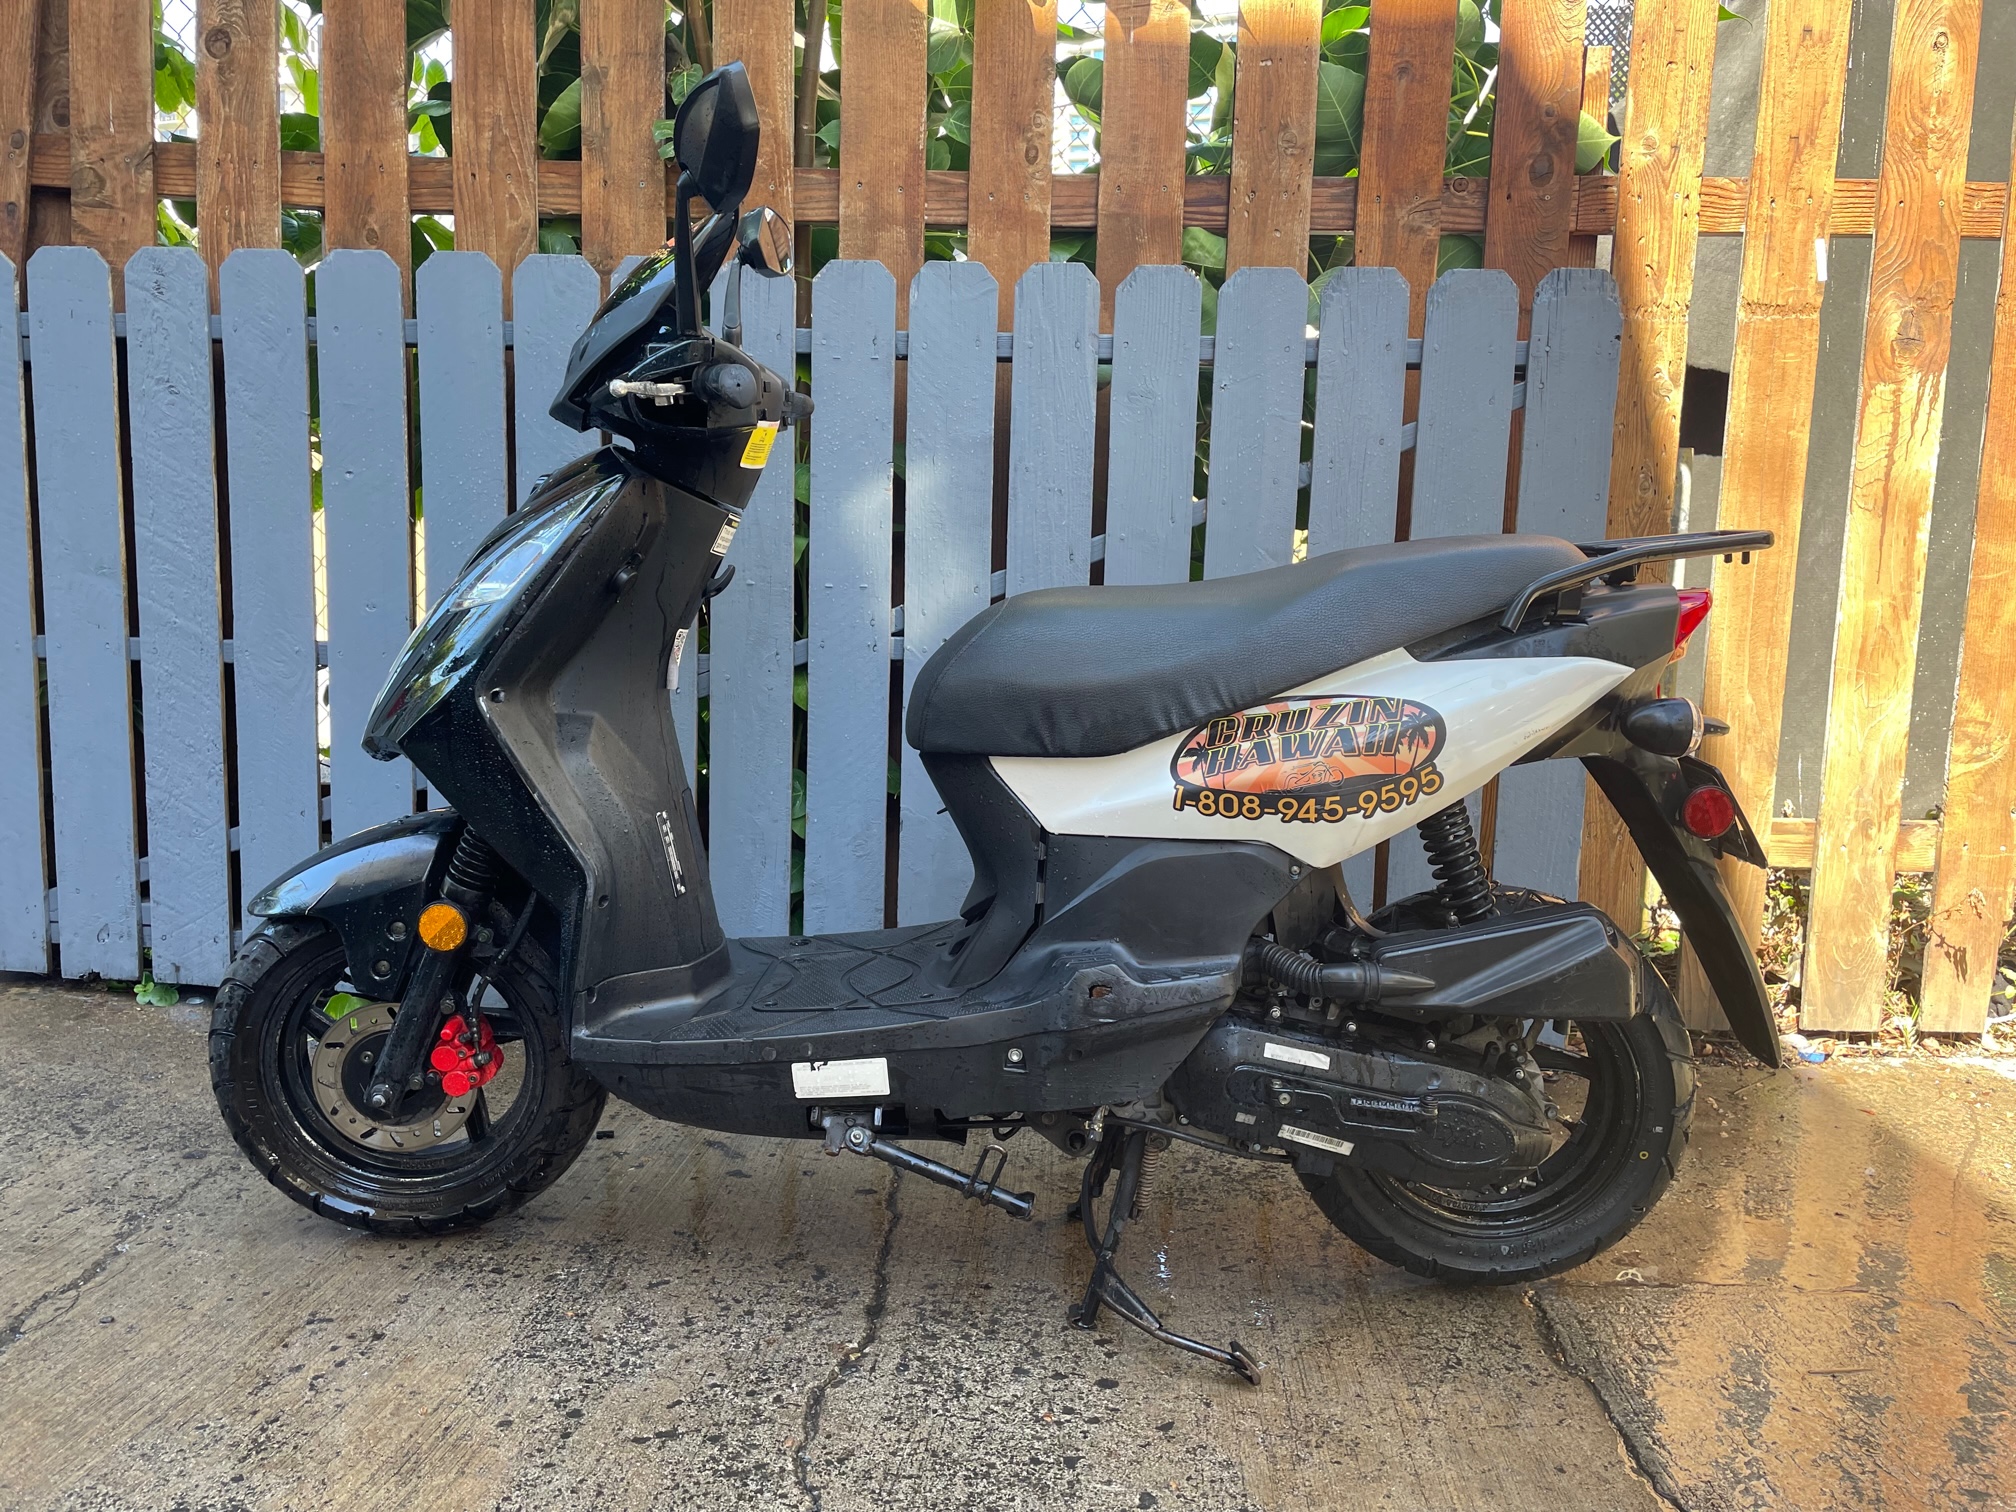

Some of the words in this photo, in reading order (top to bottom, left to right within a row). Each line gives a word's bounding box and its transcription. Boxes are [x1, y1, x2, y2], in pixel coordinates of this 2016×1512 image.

[1204, 697, 1405, 750] CRUZIN
[1204, 721, 1403, 778] HAWAII
[1173, 766, 1442, 823] 1-808-945-9595
